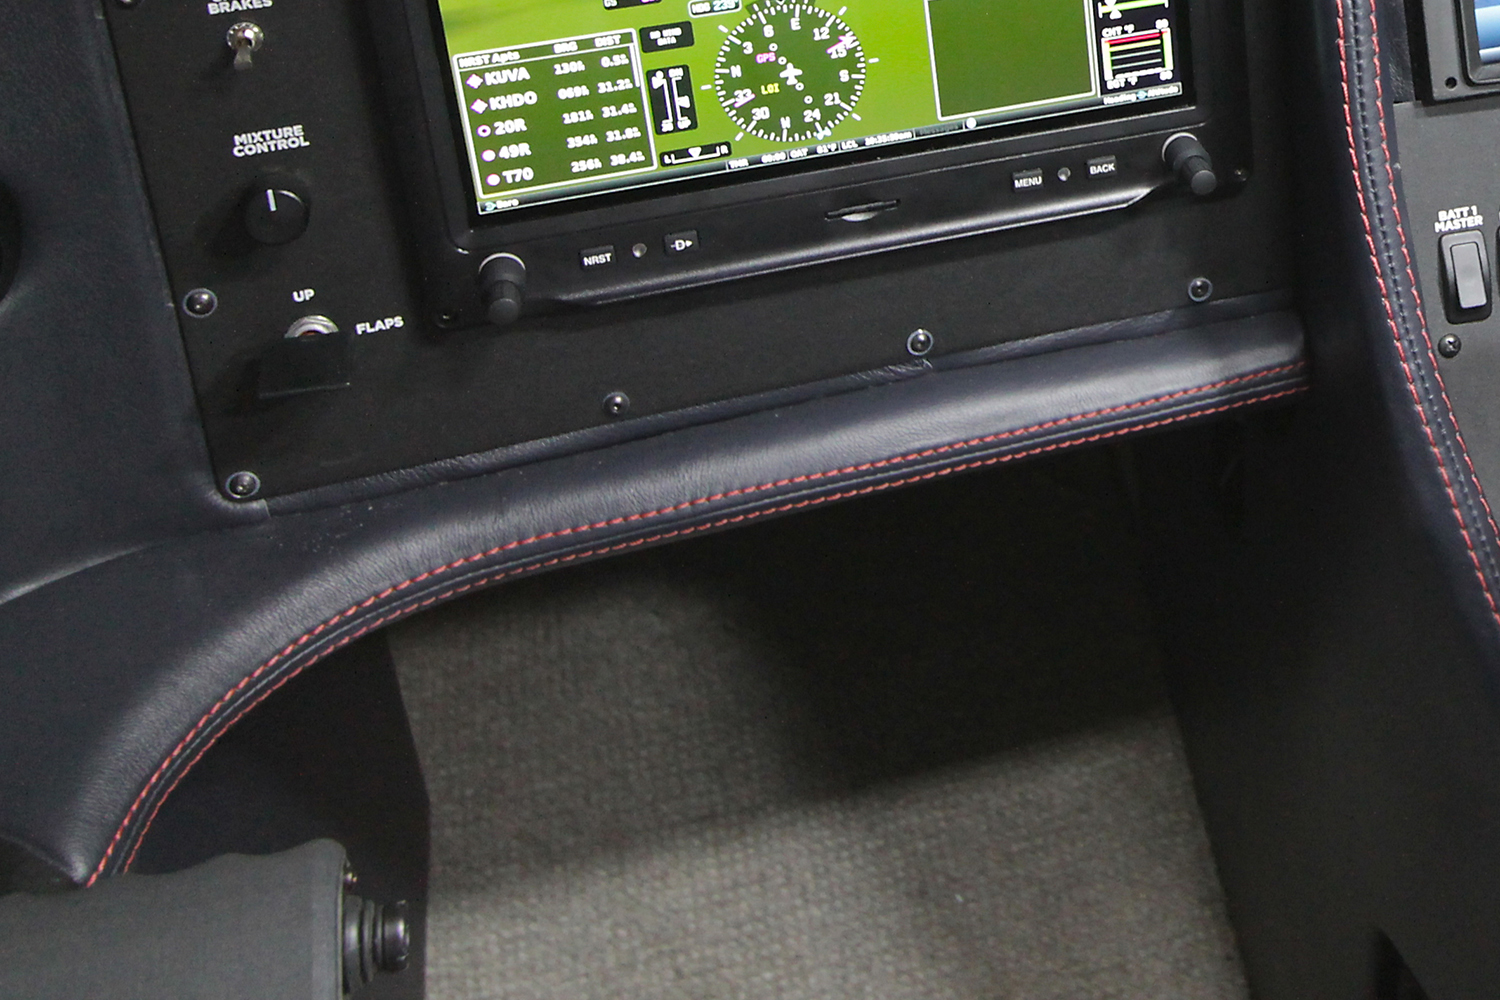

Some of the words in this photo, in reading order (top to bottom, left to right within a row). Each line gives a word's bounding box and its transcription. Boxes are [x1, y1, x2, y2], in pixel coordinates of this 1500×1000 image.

[790, 18, 801, 30] E
[763, 25, 774, 37] 6
[813, 27, 830, 41] 12
[742, 42, 753, 55] 3
[492, 50, 520, 64] Apts
[756, 52, 776, 63] GPS
[485, 67, 530, 86] KUVA
[731, 66, 741, 78] N
[839, 70, 849, 82] S
[761, 84, 780, 95] LOI
[489, 91, 538, 110] KHDO
[824, 92, 840, 105] 21
[752, 107, 770, 120] 30
[803, 109, 821, 123] 24
[493, 118, 527, 135] 20R
[234, 125, 304, 146] MIXTURE
[232, 136, 310, 157] CONTROL
[498, 143, 532, 160] 49R
[502, 167, 534, 183] T70
[1090, 163, 1115, 175] BACK
[1014, 176, 1042, 188] MENU
[1438, 207, 1468, 222] BATT
[1434, 215, 1484, 233] MASTER
[583, 253, 612, 266] NRST
[293, 289, 315, 302] UP
[356, 316, 404, 335] FLAPS
